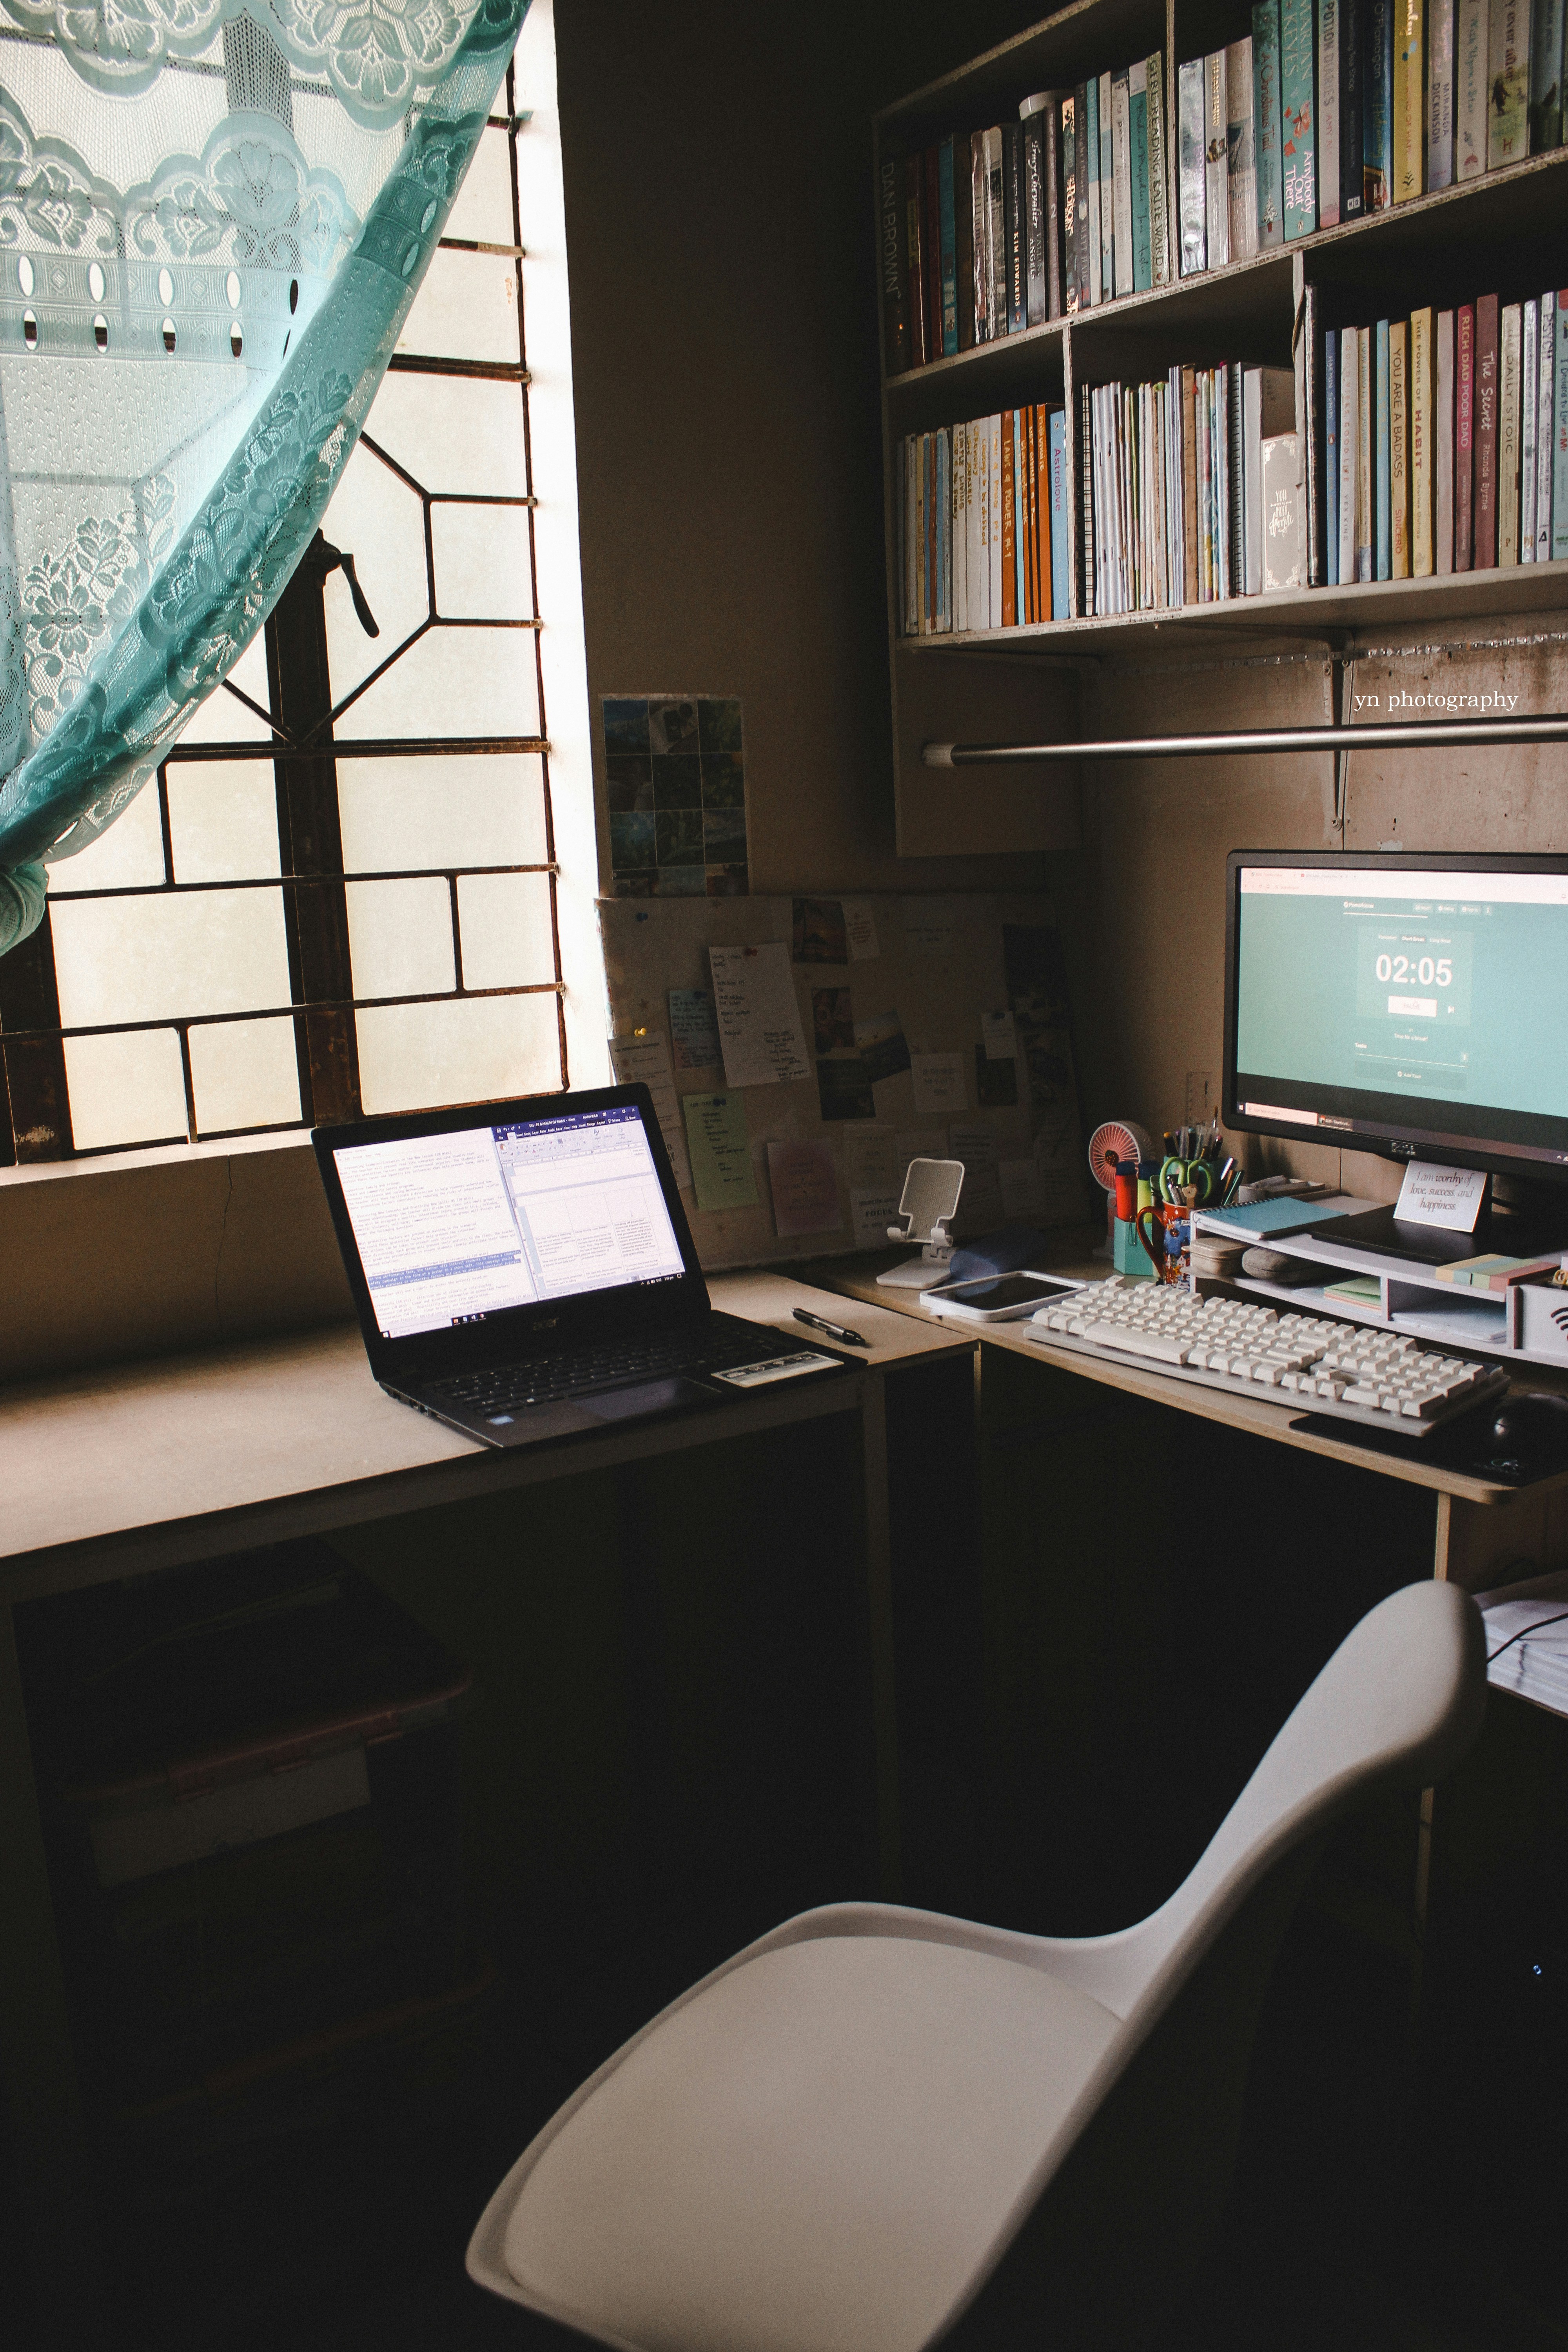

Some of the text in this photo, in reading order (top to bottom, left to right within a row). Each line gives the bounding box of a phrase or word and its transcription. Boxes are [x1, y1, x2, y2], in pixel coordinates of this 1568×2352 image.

[1283, 13, 1298, 77] KEYES
[1299, 0, 1312, 80] MARIAN
[1323, 2, 1335, 107] POTION DIARIES
[1506, 11, 1515, 44] ever
[1505, 48, 1517, 82] after
[1149, 60, 1161, 173] GIRL READING
[1261, 65, 1273, 129] Christmas
[1432, 82, 1441, 145] DICKINSON
[1262, 124, 1275, 152] Tail
[1028, 140, 1042, 229] Tracy Chevalier
[1285, 164, 1296, 211] There
[1294, 178, 1304, 207] Out
[1301, 151, 1315, 214] Anybody
[882, 162, 898, 293] DAN BROWN
[1153, 180, 1164, 267] KATIE WARD
[1416, 388, 1421, 401] OF
[1461, 315, 1470, 447] RICH DAD POOR DAD
[1481, 351, 1494, 431] The Secret
[1393, 348, 1403, 478] YOU ARE A BADASS
[1004, 488, 1013, 533] POWER
[1054, 448, 1062, 512] Astrolove
[1480, 483, 1490, 510] Byrne
[1375, 954, 1452, 986] 02:05
[1435, 1172, 1463, 1187] worthy
[1464, 1172, 1475, 1187] of
[1457, 1187, 1475, 1198] and
